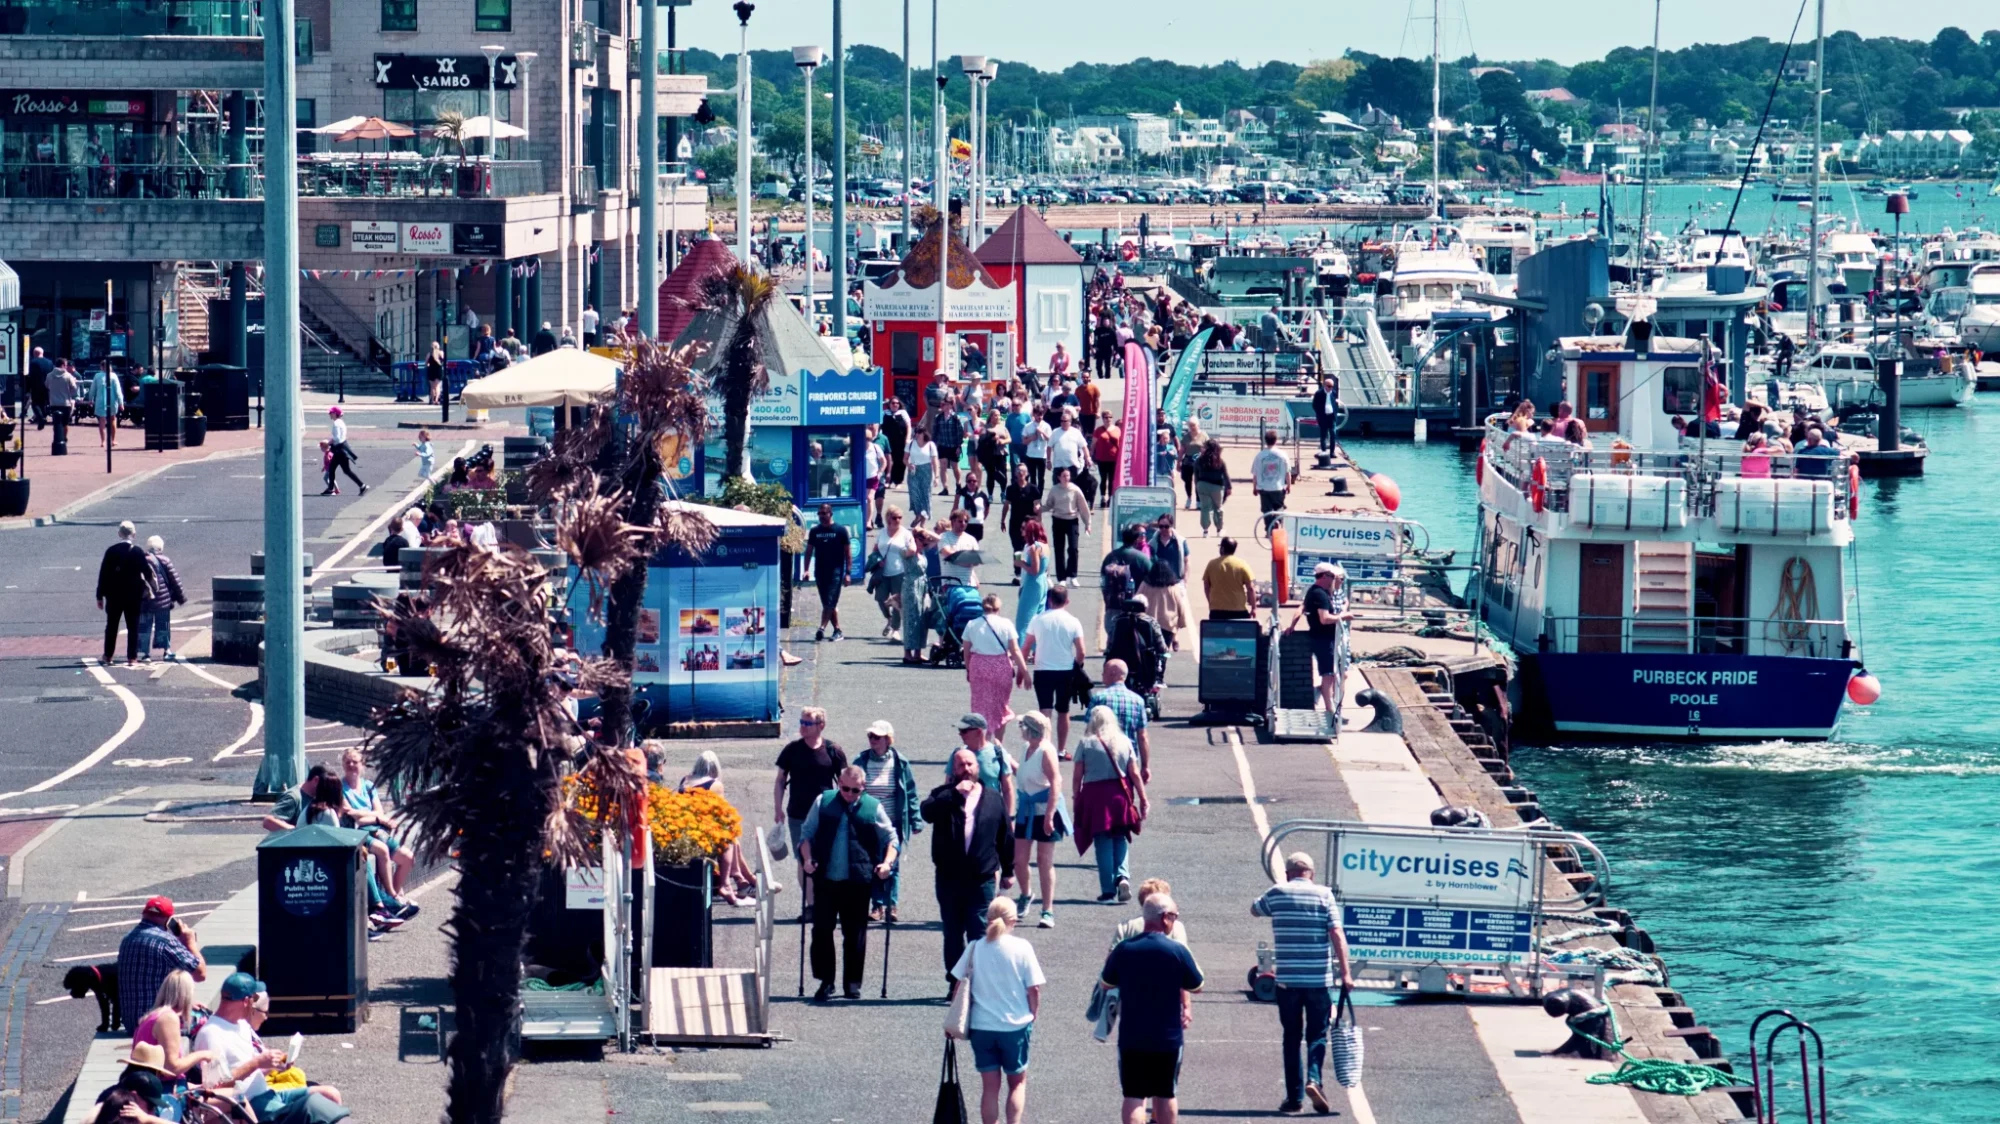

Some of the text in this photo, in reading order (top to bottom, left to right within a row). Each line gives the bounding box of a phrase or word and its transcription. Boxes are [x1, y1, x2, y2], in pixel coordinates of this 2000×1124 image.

[12, 94, 79, 114] Rosso's
[354, 233, 395, 241] STEAK HOUSE
[409, 225, 442, 241] Rosso's
[1237, 358, 1254, 368] River
[809, 392, 877, 401] FIREWORKS CRUISES
[754, 405, 772, 413] 400
[774, 405, 791, 413] 400
[820, 406, 865, 415] PRIVATE HIRE
[1220, 406, 1262, 414] SANDBANKS
[1300, 524, 1380, 541] citycruises
[1633, 669, 1758, 685] PURBECK PRIDE
[1670, 694, 1718, 705] POOLE
[1689, 710, 1700, 719] 16
[1342, 848, 1500, 879] citycruises
[1436, 880, 1498, 891] by Hornblower
[1350, 948, 1522, 962] WWW.CITYCRUISESPOOLE.COM
